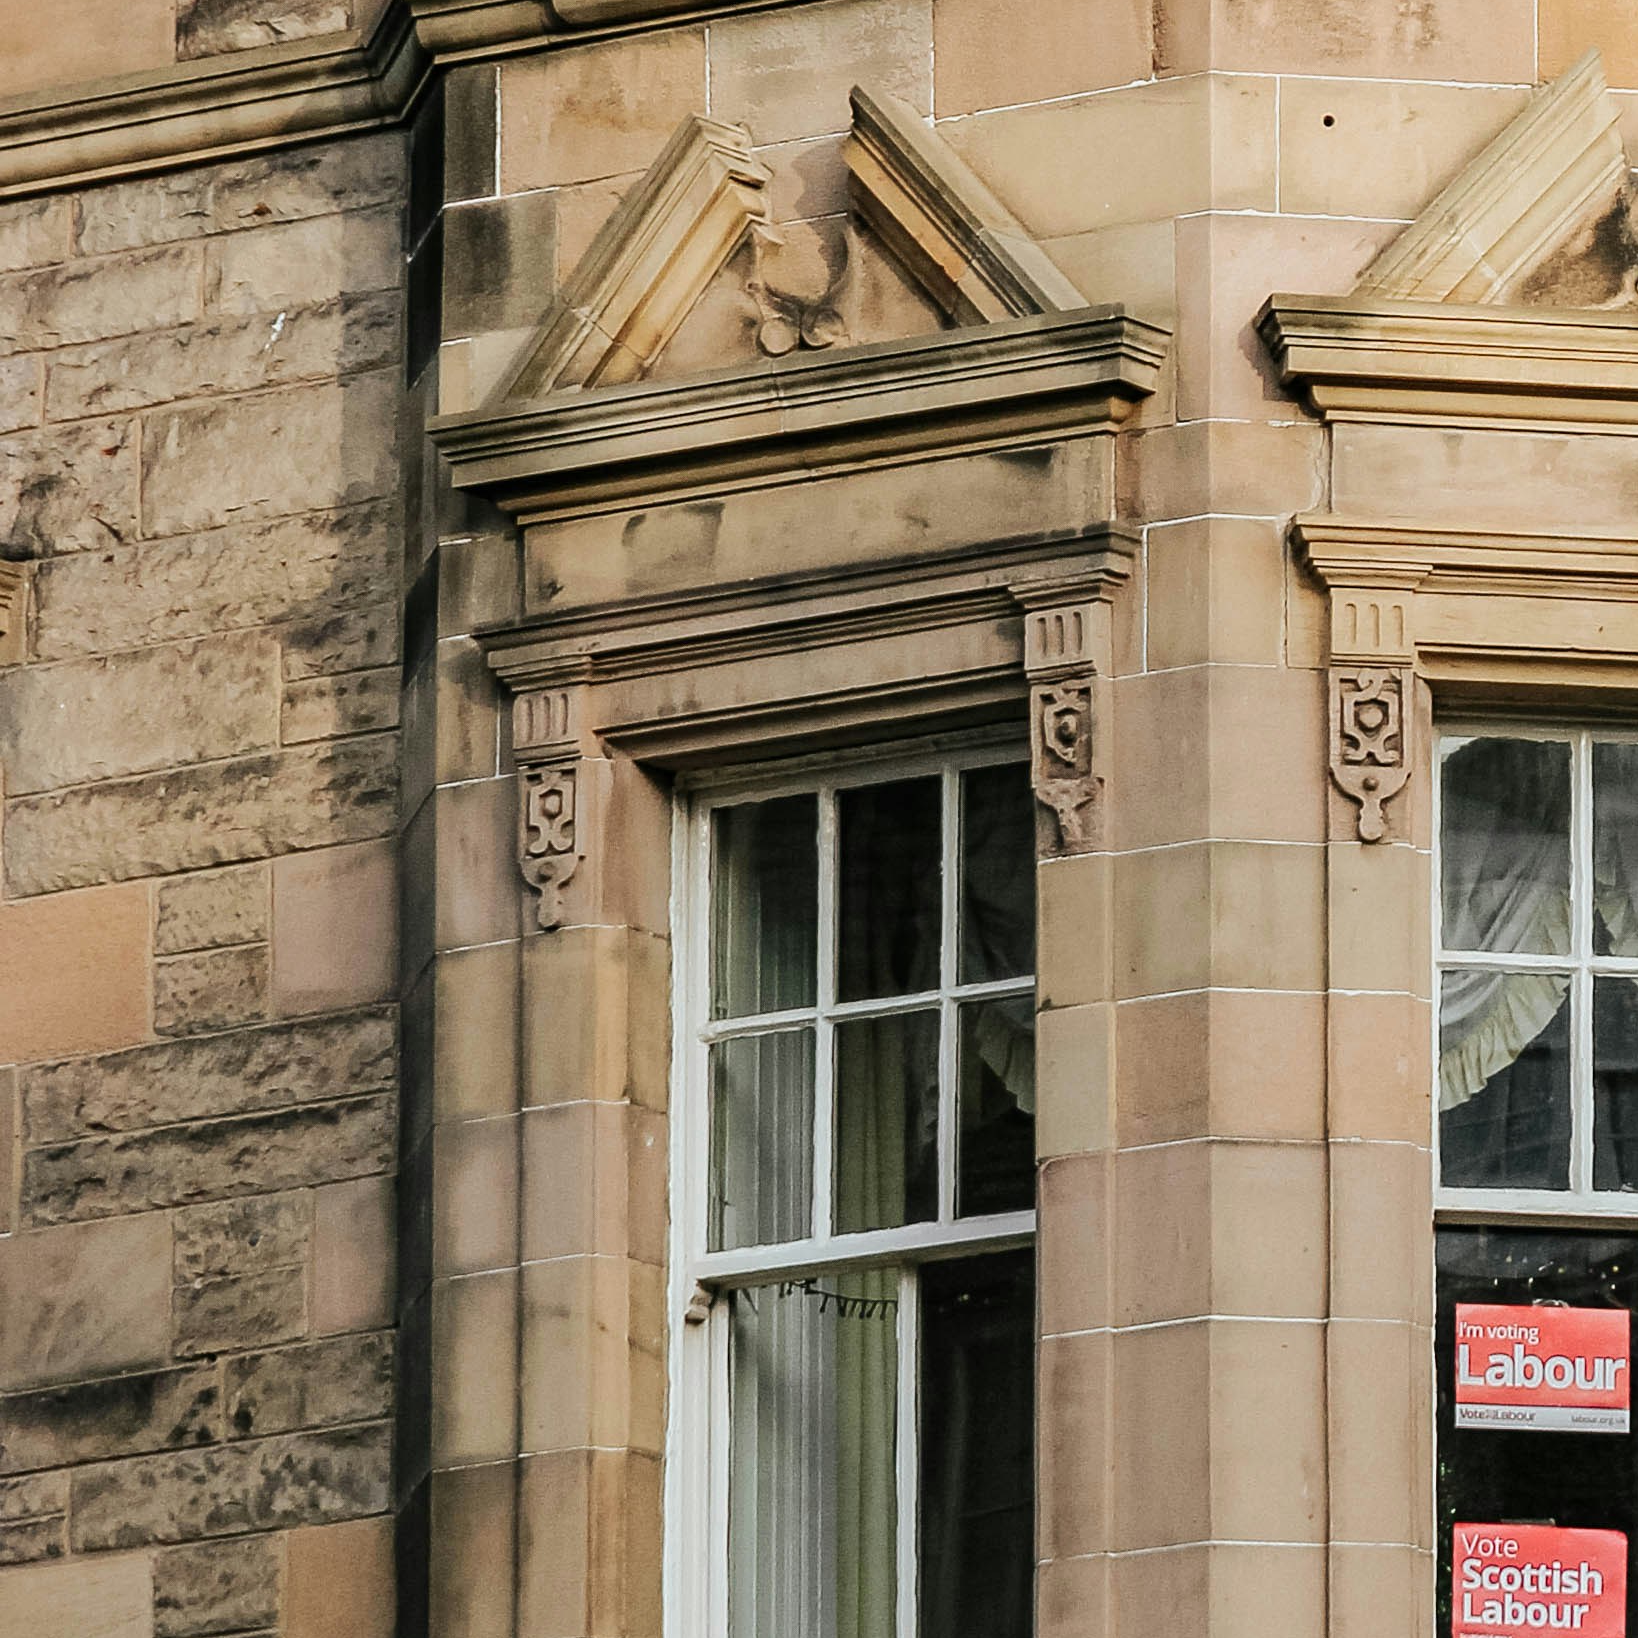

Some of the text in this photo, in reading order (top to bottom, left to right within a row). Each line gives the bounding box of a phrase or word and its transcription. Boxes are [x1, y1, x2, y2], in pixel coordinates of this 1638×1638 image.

[1458, 1322, 1539, 1344] I'm voting
[1458, 1343, 1626, 1390] Labour
[1459, 1408, 1536, 1421] Vote Labour
[1461, 1533, 1518, 1558] Vote
[1462, 1559, 1603, 1595] Scottish
[1463, 1593, 1589, 1629] Labour
